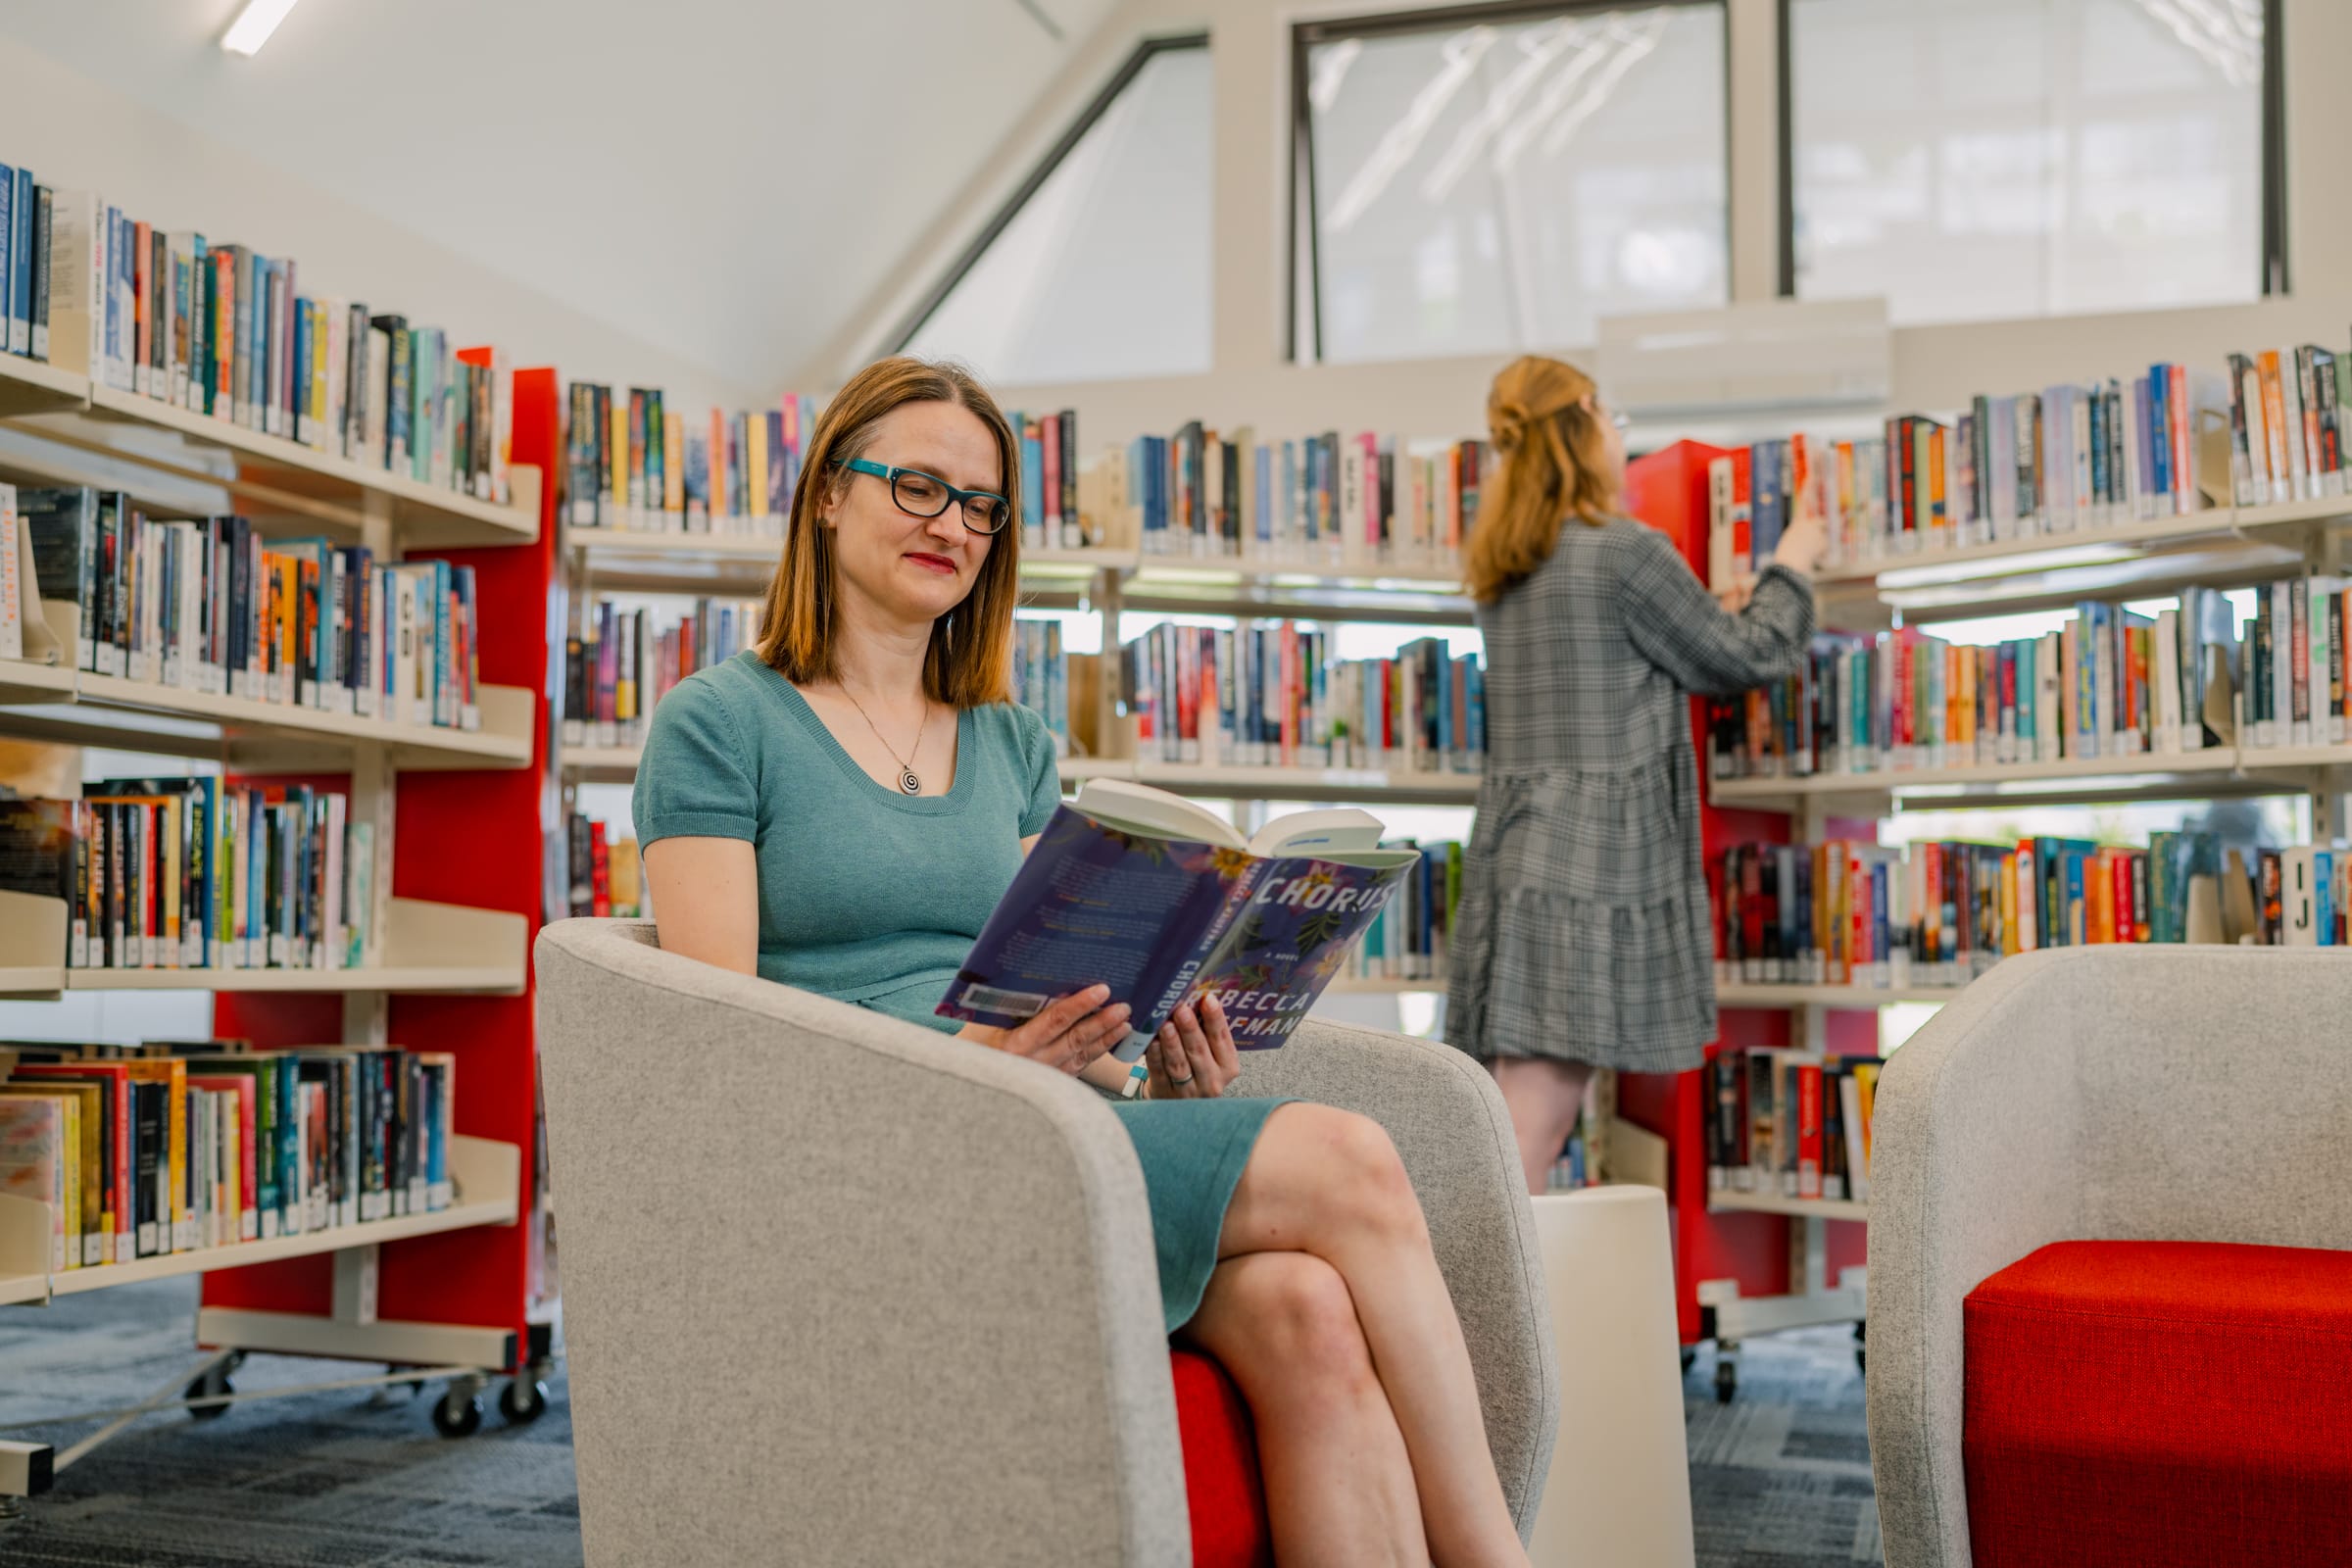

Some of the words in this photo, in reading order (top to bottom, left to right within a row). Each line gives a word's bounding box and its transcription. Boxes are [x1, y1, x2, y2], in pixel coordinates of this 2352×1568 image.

[1230, 861, 1263, 904] REBECCA
[1255, 878, 1398, 912] CHORUS
[2295, 898, 2309, 930] J
[1274, 954, 1300, 962] NOVEL
[1152, 959, 1201, 1019] CHORUS
